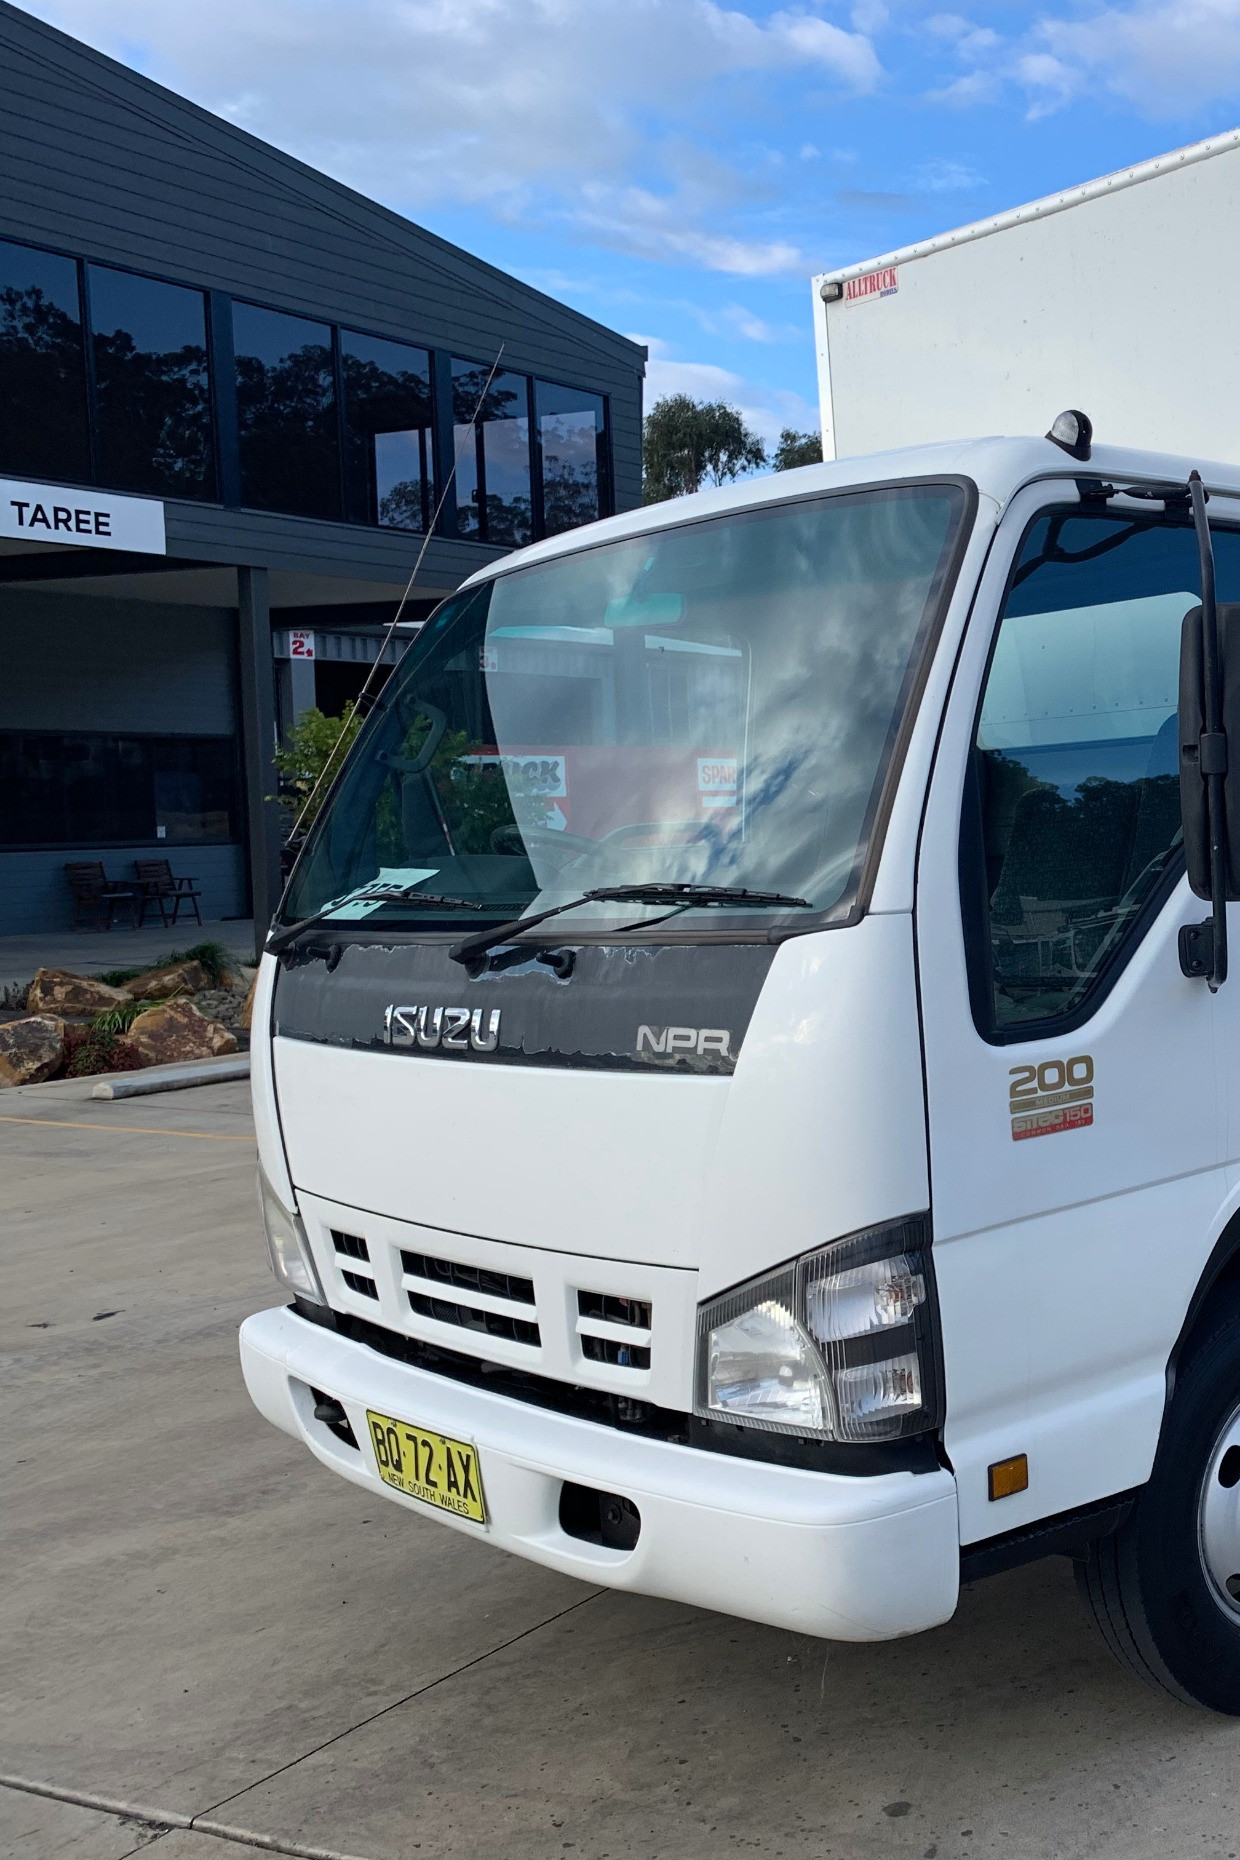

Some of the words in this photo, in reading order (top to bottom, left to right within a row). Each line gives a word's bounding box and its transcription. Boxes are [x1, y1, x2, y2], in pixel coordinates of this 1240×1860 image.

[846, 267, 897, 300] ALLTRUCK
[10, 500, 112, 537] TAREE
[291, 640, 305, 656] 2
[384, 1003, 502, 1052] ISUZU
[636, 1024, 731, 1057] NPR
[1009, 1055, 1094, 1099] 200
[388, 1472, 405, 1489] NEW
[408, 1480, 436, 1502] SOUTH
[439, 1492, 470, 1515] WALES
